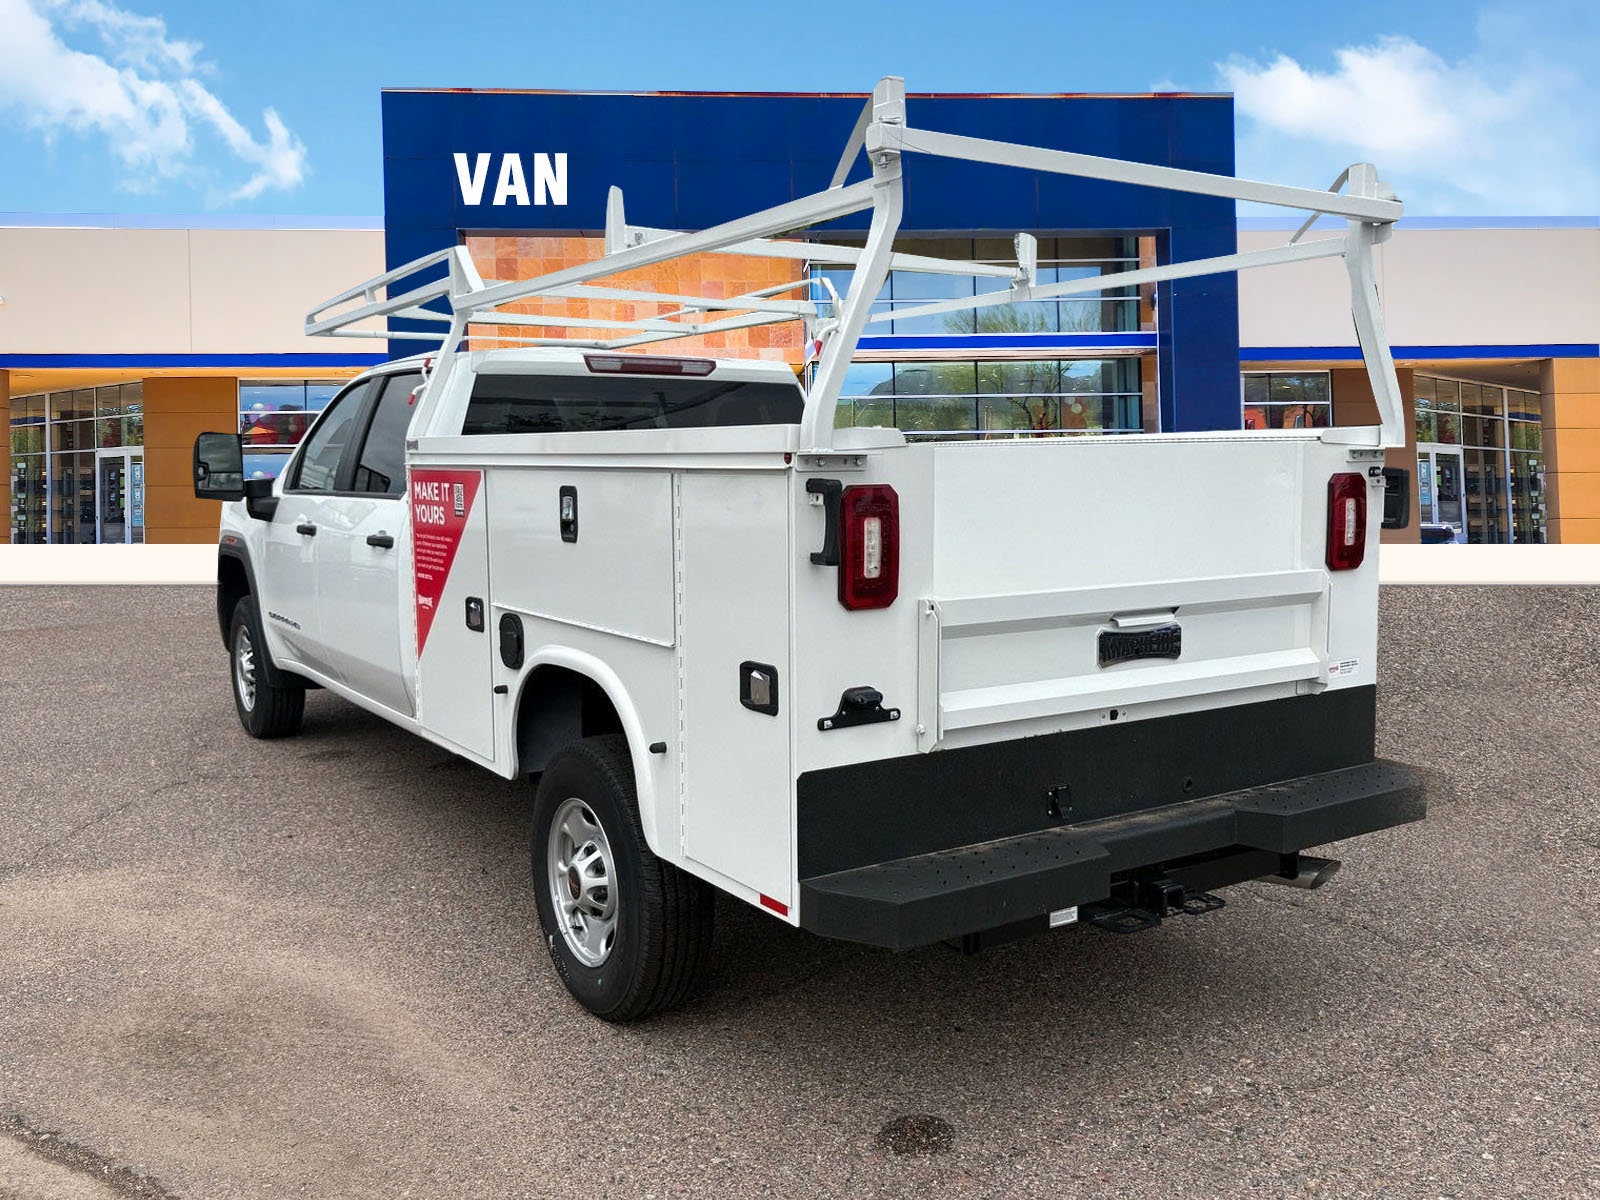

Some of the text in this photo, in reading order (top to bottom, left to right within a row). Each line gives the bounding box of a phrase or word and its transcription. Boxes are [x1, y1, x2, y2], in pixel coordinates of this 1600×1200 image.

[453, 153, 568, 206] VAN
[414, 481, 450, 502] MAKE IT
[414, 503, 446, 526] YOURS
